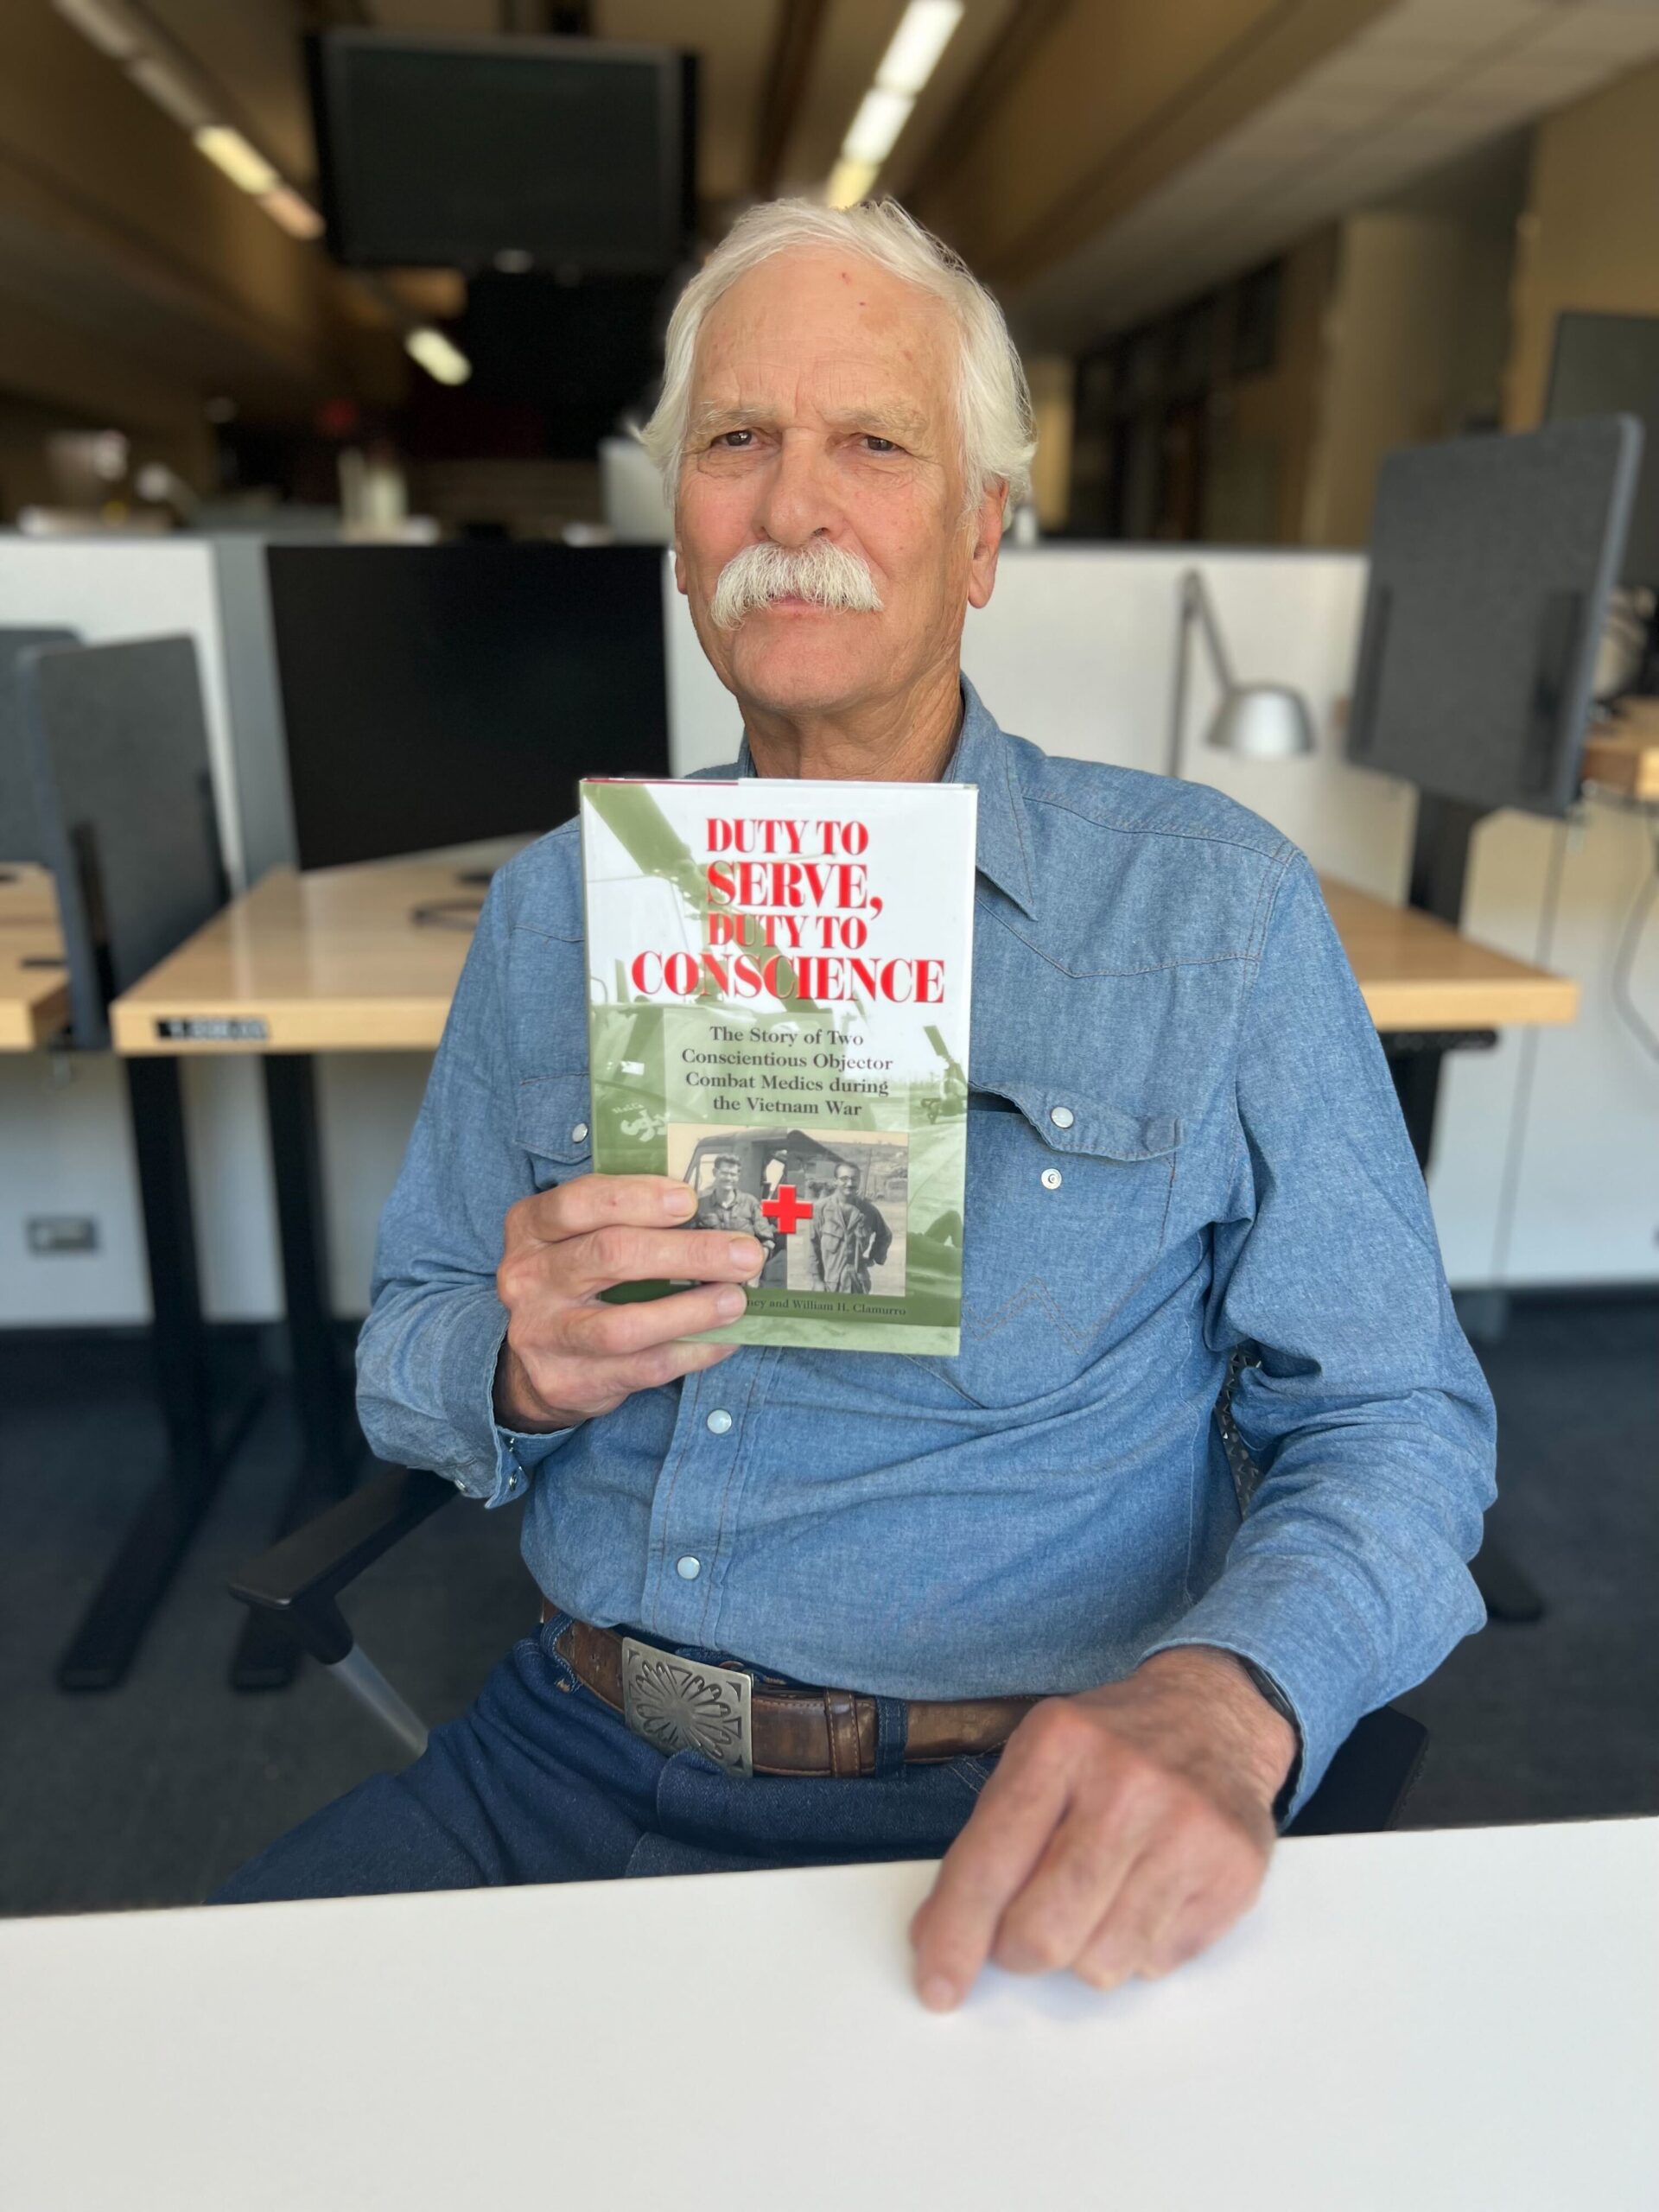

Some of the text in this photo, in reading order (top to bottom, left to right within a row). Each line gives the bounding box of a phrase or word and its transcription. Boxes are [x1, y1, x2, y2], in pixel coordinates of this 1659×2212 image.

[706, 817, 869, 855] DUTY TO
[706, 860, 883, 920] SERVE,
[708, 912, 868, 950] DUTY TO
[631, 950, 944, 1003] CONSCIENCE
[709, 1026, 864, 1046] The Story of Two
[682, 1048, 893, 1072] Conscientious Objector
[685, 1071, 889, 1096] Combat Medics during
[713, 1096, 862, 1116] the Vietnam War
[746, 1299, 765, 1309] ney
[769, 1300, 789, 1308] and
[791, 1299, 834, 1312] William
[853, 1303, 906, 1316] Clamurro
